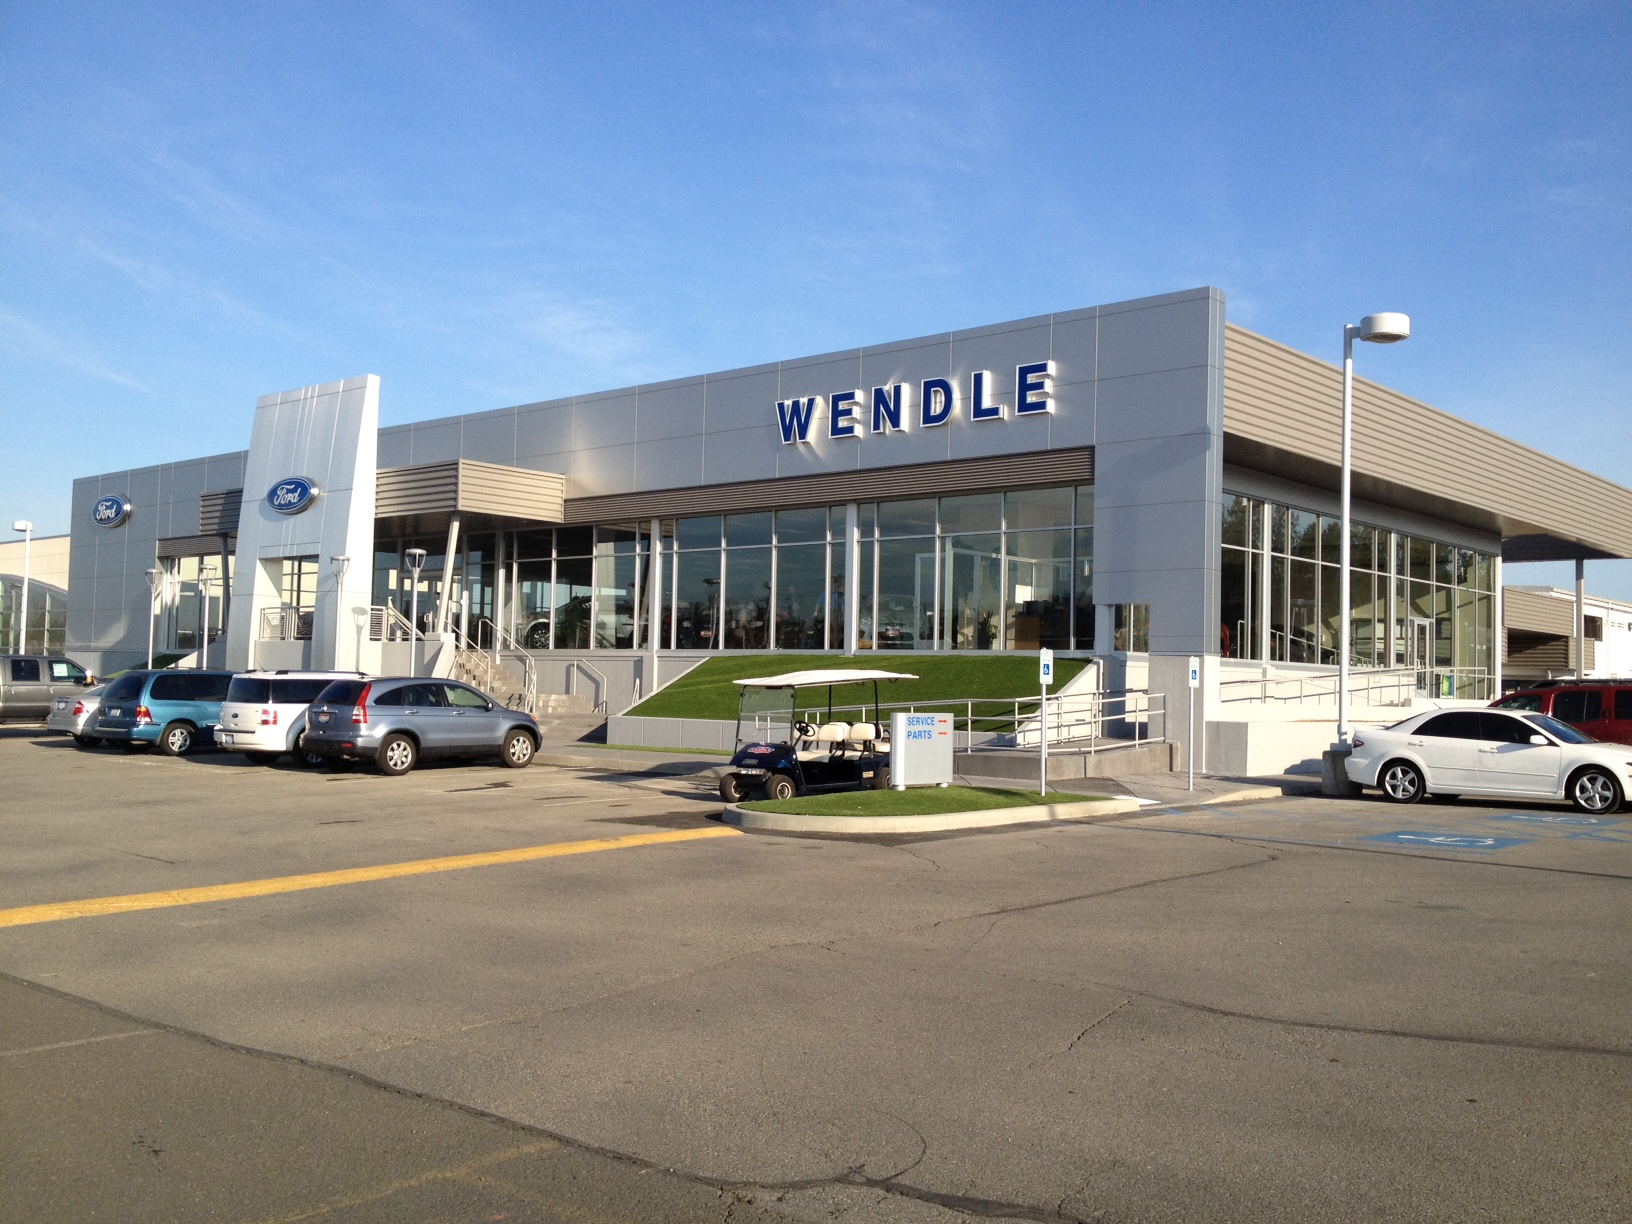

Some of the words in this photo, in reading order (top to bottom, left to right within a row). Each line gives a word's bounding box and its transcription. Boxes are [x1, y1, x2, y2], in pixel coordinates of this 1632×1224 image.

[775, 360, 1056, 444] WENDLE
[273, 484, 302, 506] Ford
[96, 501, 117, 520] Ford
[907, 716, 935, 726] SERVICE
[907, 730, 932, 740] PARTS
